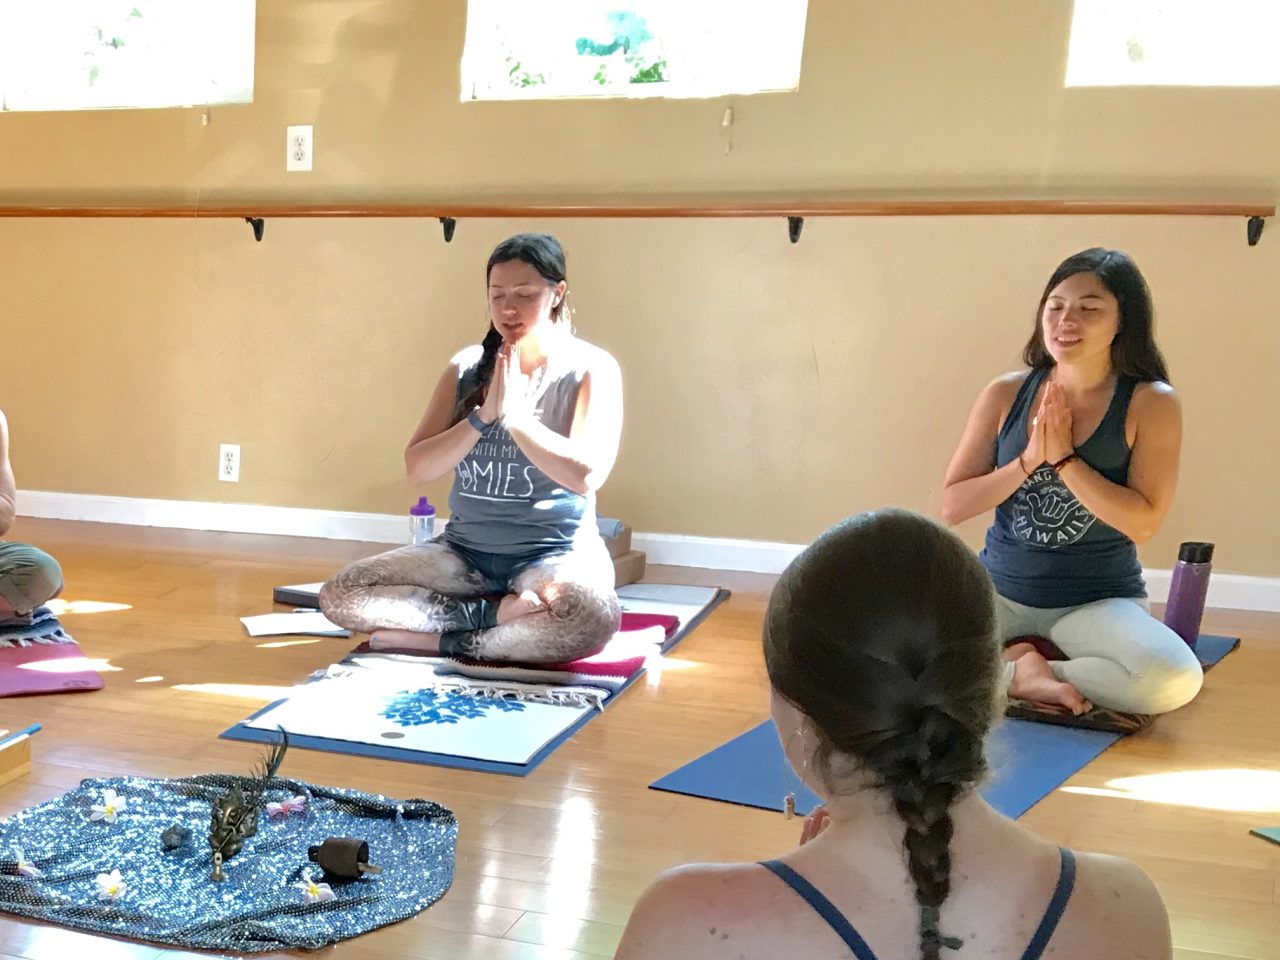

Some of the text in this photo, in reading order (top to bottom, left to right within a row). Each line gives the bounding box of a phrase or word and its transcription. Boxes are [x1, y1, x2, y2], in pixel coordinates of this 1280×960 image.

[470, 442, 519, 460] WITH MY
[1016, 515, 1084, 544] HAWAII
